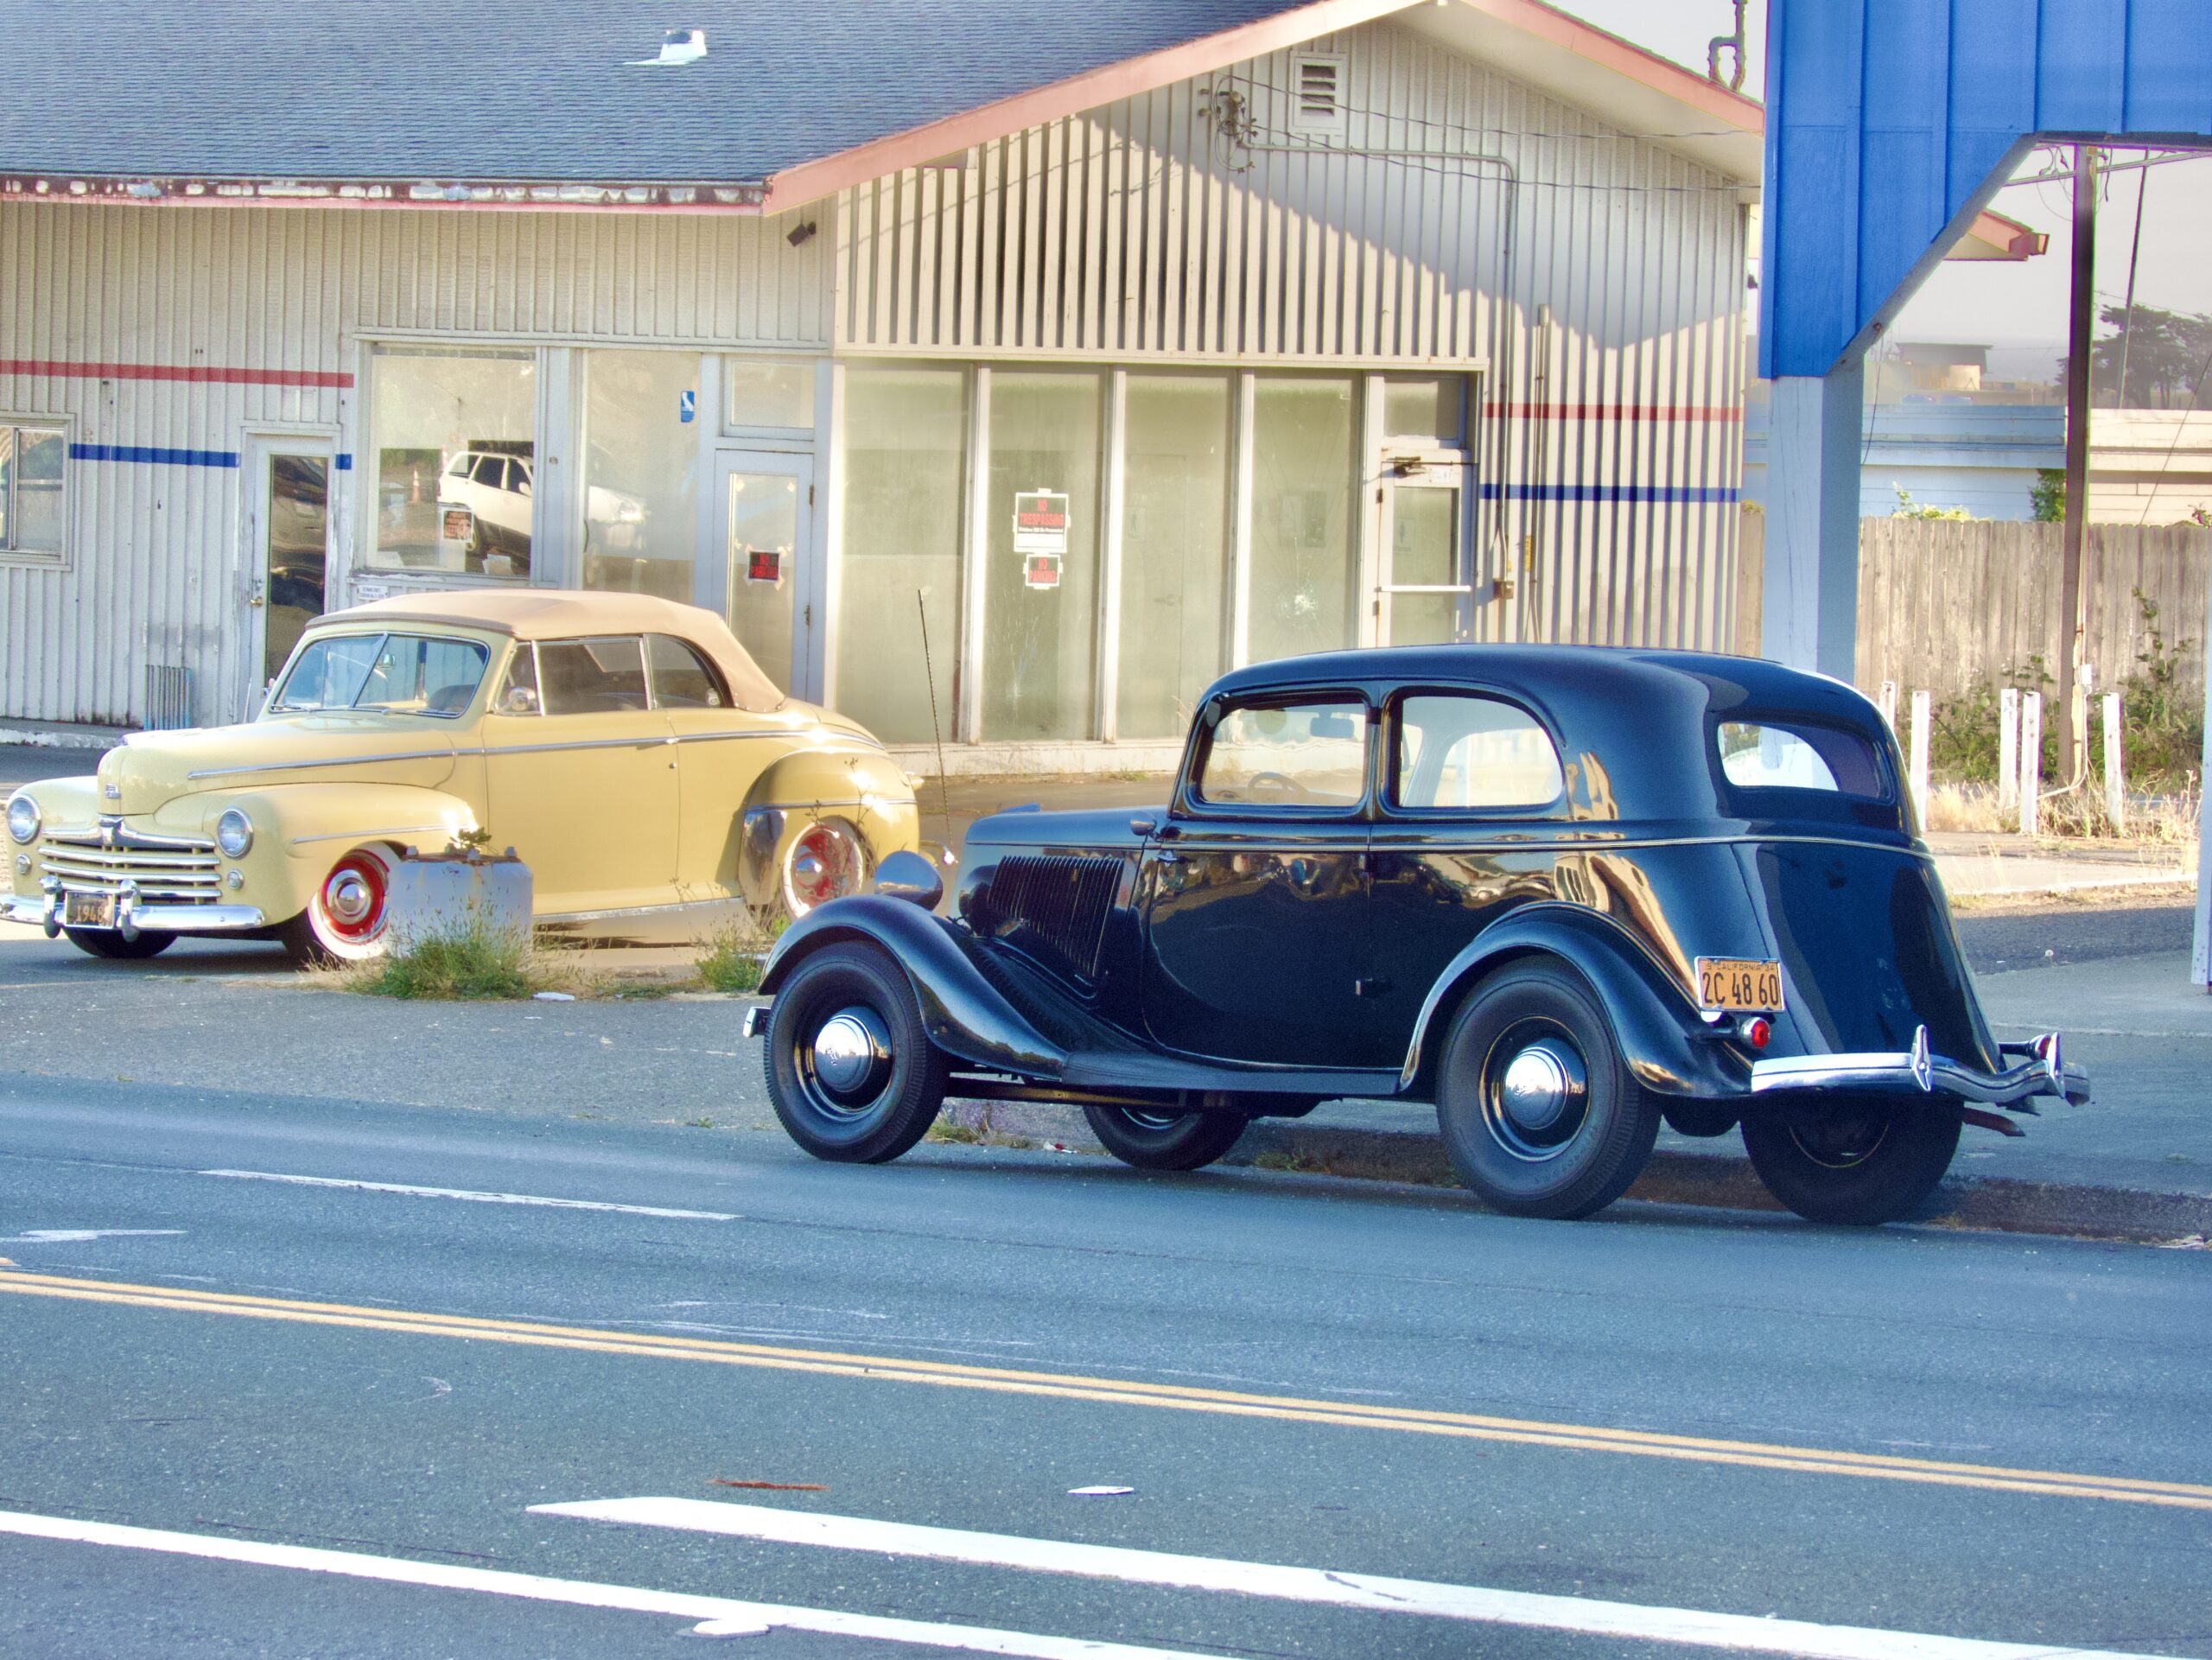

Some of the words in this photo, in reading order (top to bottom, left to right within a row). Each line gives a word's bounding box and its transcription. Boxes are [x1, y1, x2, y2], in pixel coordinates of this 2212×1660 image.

[1037, 499, 1047, 512] NO
[1020, 512, 1065, 526] TRESPASSING
[760, 553, 769, 565] NO
[1038, 557, 1047, 569] NO
[751, 566, 777, 578] PARKING
[1029, 570, 1057, 582] PARKING
